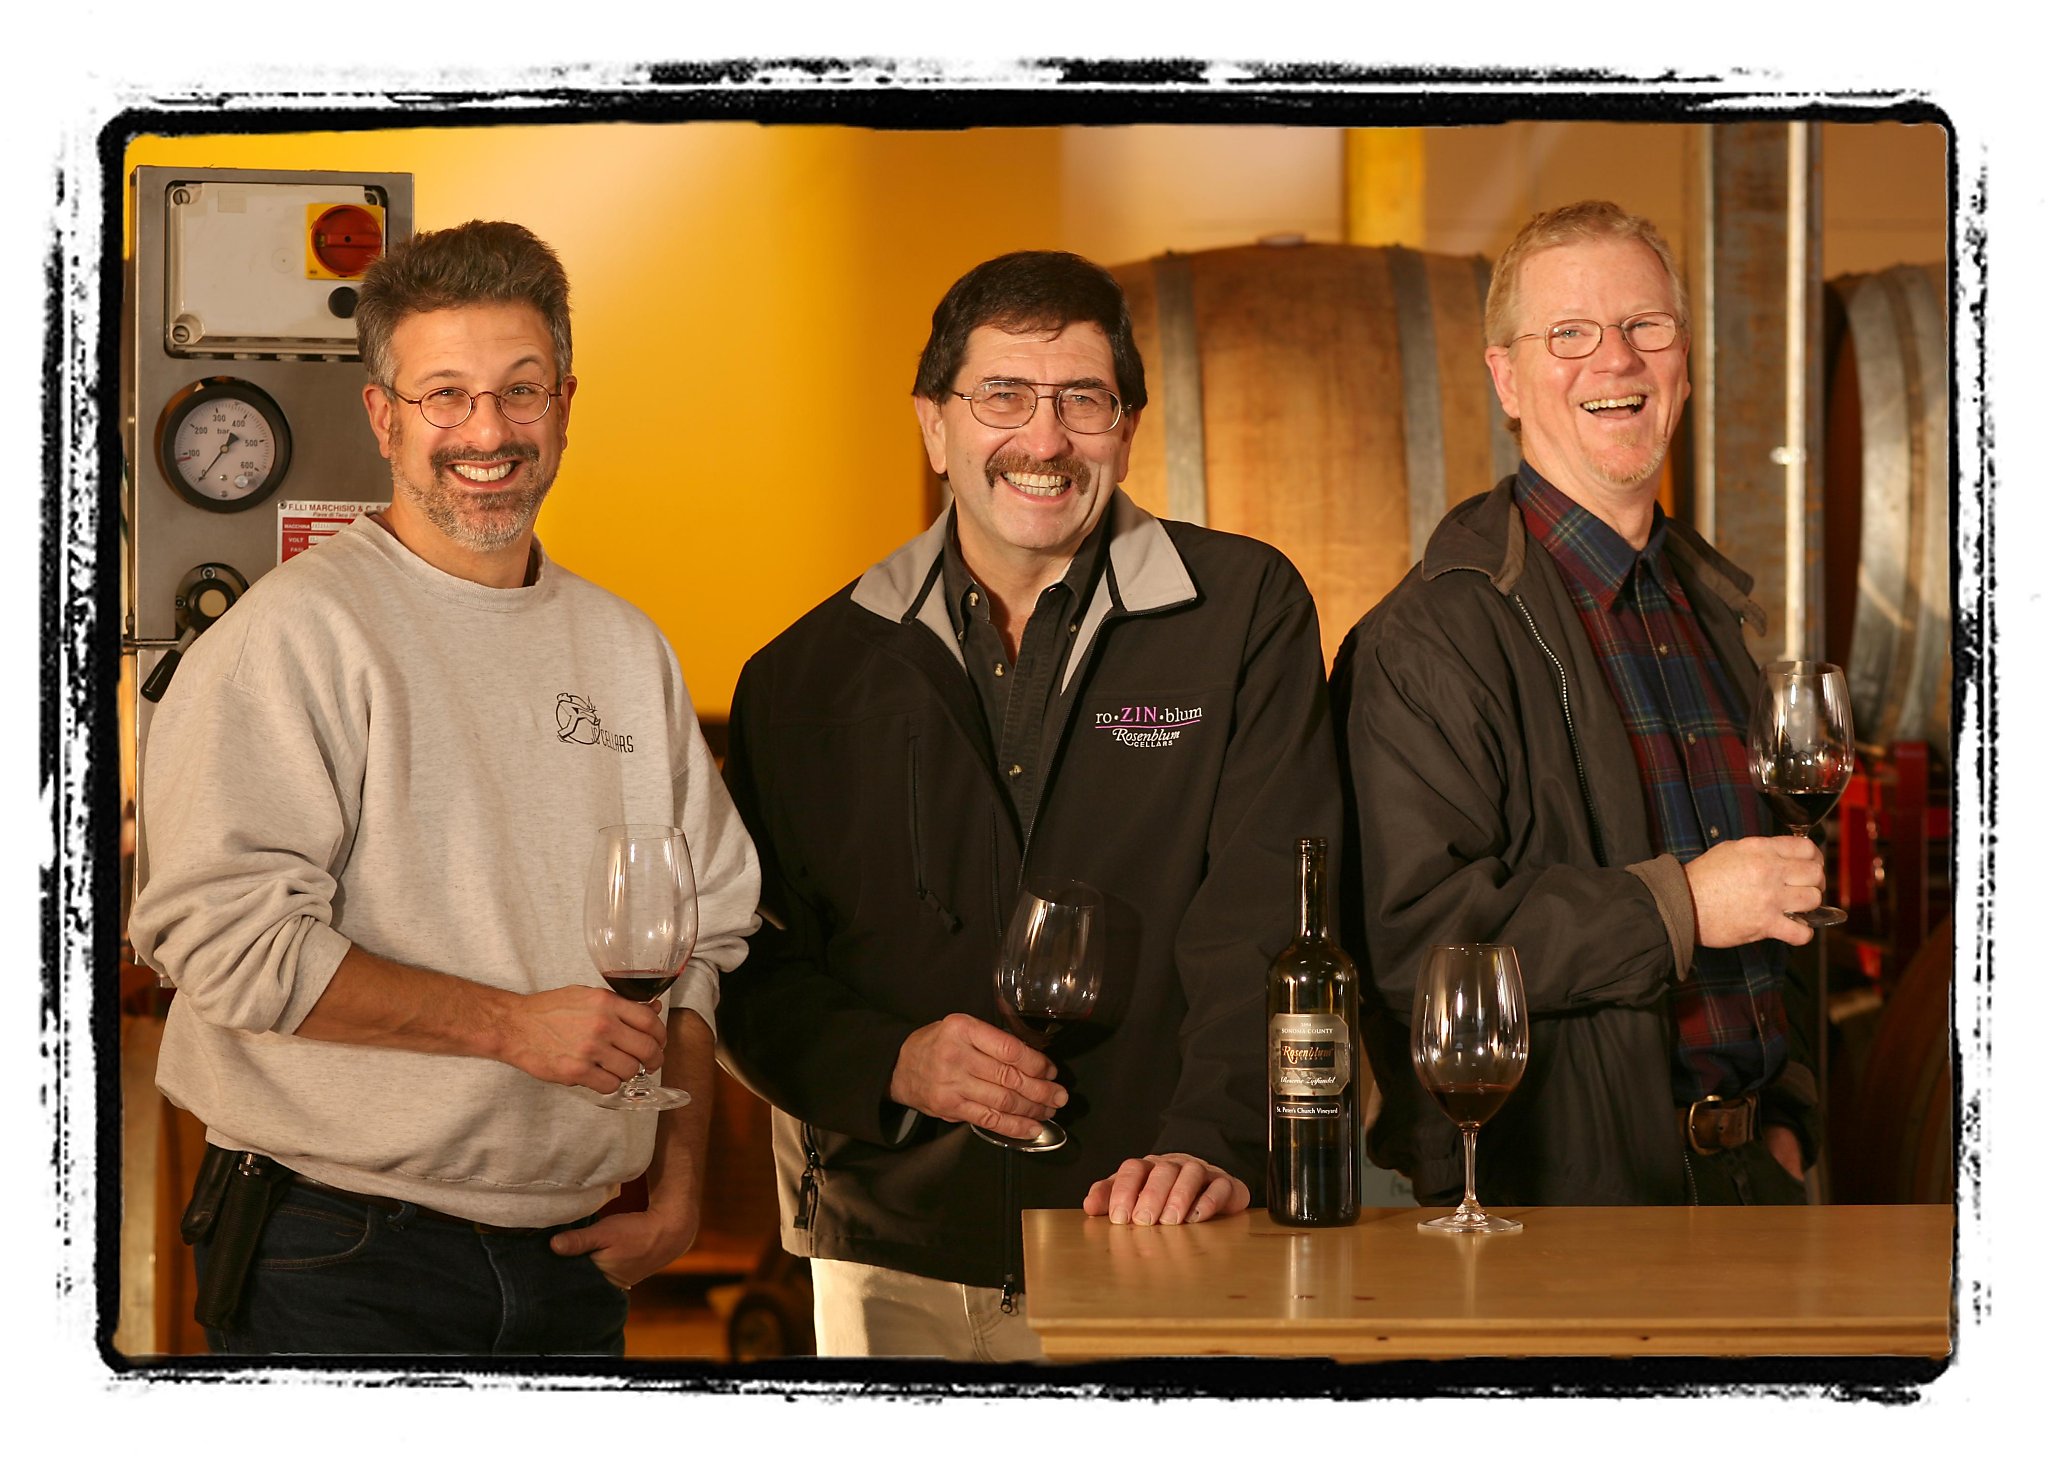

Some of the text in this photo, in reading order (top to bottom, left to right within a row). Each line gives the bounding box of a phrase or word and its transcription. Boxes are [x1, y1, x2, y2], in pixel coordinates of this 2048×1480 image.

[213, 414, 226, 422] 300
[231, 420, 245, 428] 400
[194, 427, 208, 435] 200
[244, 439, 258, 447] 500
[188, 449, 200, 457] 100
[240, 461, 254, 469] 600
[309, 504, 356, 513] MARCHISIO
[357, 504, 364, 513] &
[600, 728, 634, 754] CELLARS
[1112, 728, 1181, 746] Rosenblum
[1133, 740, 1173, 748] CELLARS
[1281, 1045, 1334, 1065] Rosenblum
[1316, 1107, 1338, 1115] Vineyard
